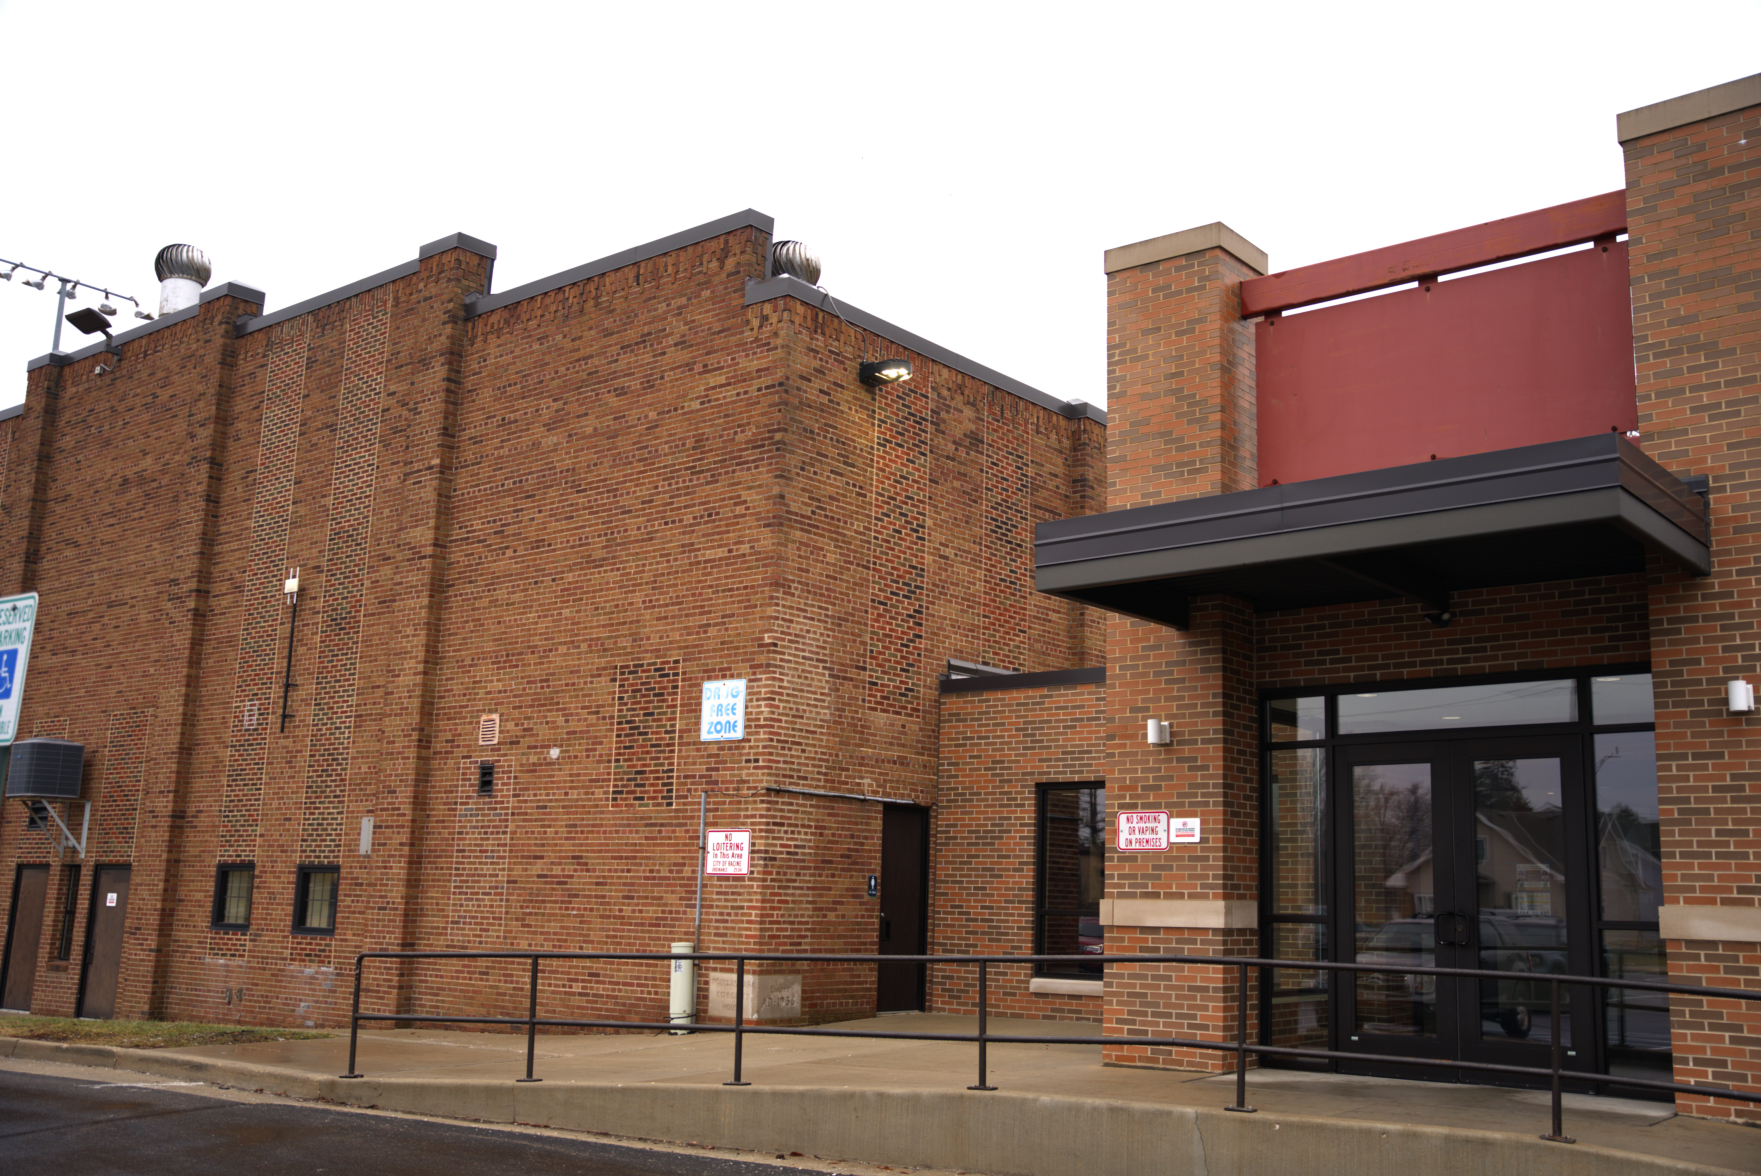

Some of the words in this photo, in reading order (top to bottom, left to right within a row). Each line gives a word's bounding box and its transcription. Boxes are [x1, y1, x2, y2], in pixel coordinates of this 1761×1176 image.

[0, 604, 33, 626] ESERVED
[0, 627, 27, 647] ARKING
[710, 702, 737, 717] FREE
[706, 719, 738, 735] ZONE
[1126, 814, 1134, 824] NO
[1135, 814, 1161, 824] SMOKING
[1128, 826, 1136, 836] OR
[1137, 825, 1158, 836] VAPING
[724, 833, 733, 841] NO
[1124, 837, 1133, 848] ON
[1134, 837, 1162, 848] PREMISES
[712, 842, 744, 851] LOITERING
[712, 851, 718, 859] In
[719, 851, 730, 859] This
[731, 851, 743, 859] Area
